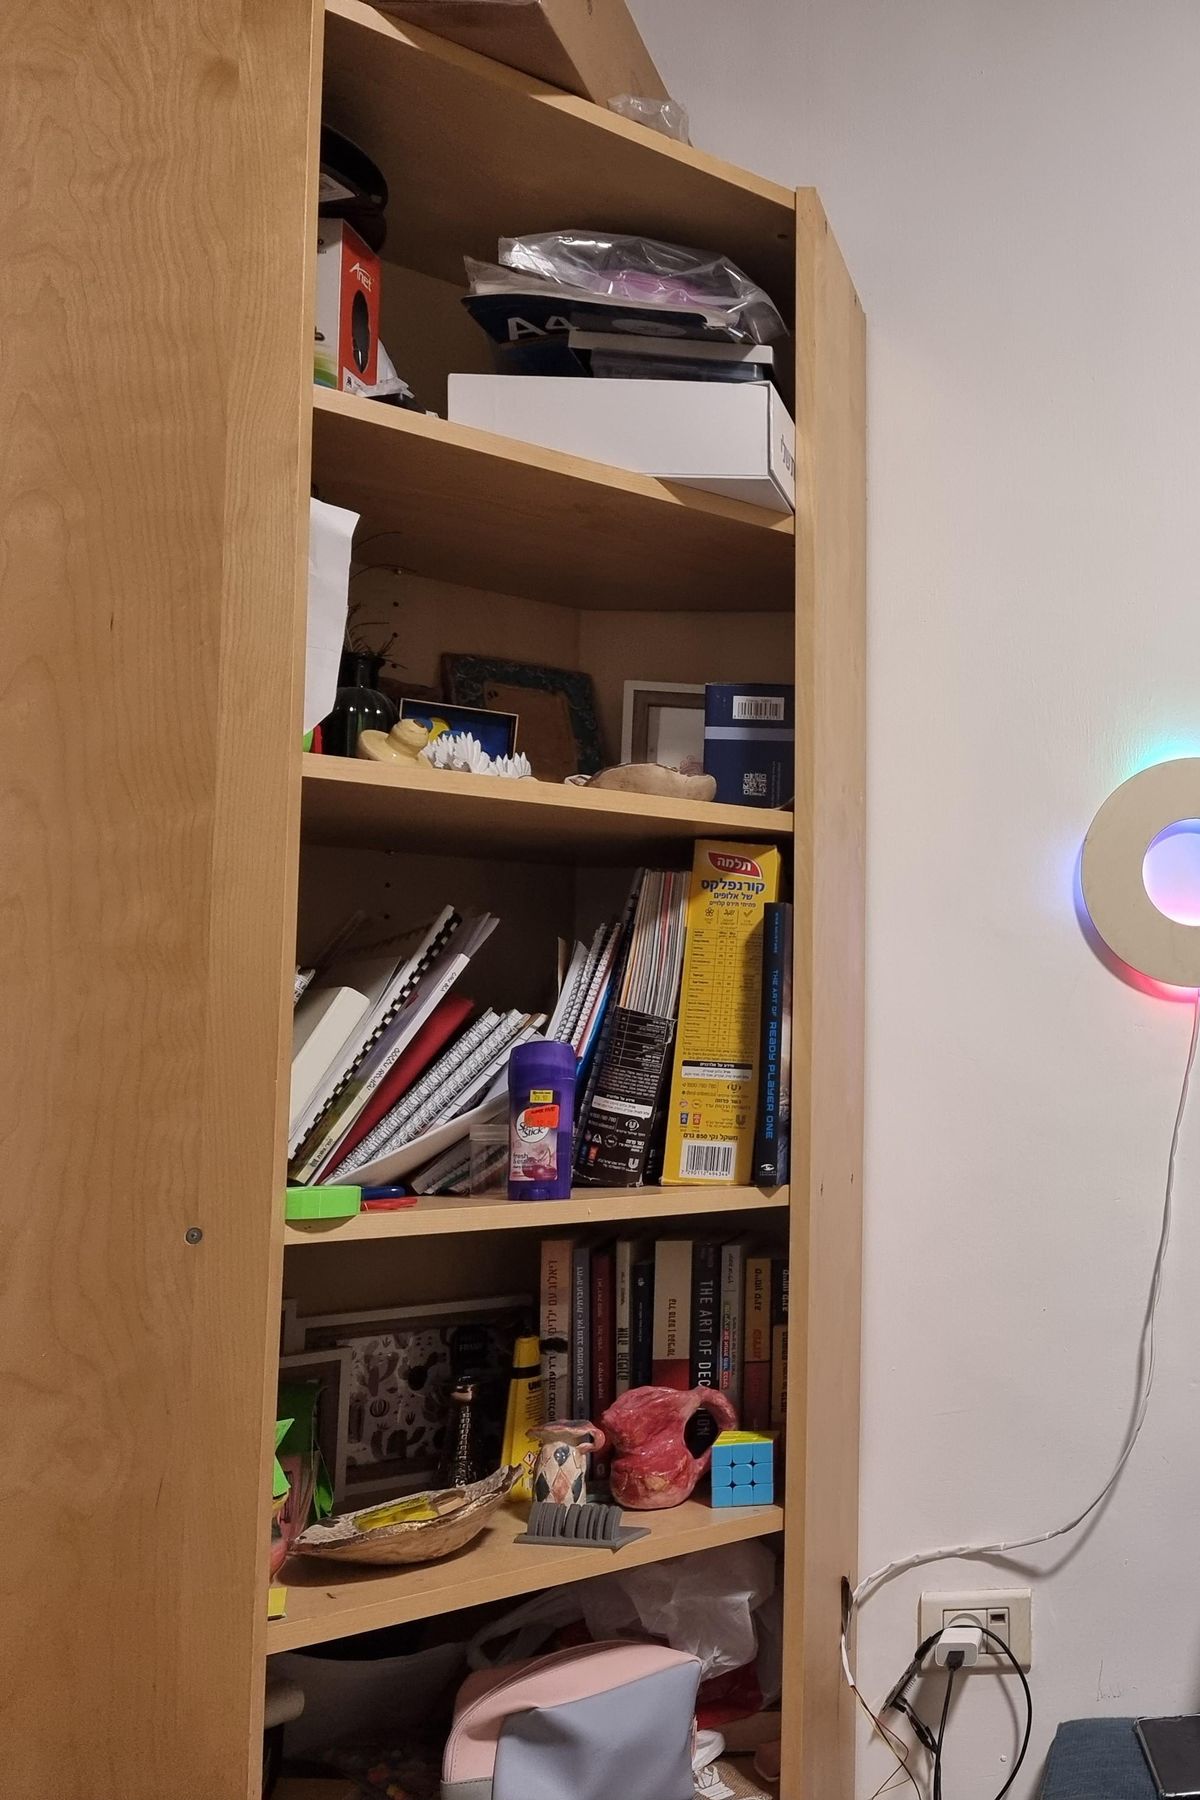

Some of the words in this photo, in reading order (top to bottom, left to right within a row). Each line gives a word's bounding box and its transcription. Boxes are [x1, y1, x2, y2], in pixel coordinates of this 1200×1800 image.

[350, 262, 373, 292] Anet
[507, 315, 580, 341] A4
[717, 857, 752, 872] תלמה
[701, 878, 765, 895] קורנפלקס
[714, 891, 739, 900] אלופים
[741, 892, 753, 901] של
[771, 1005, 778, 1017] OF
[768, 1021, 777, 1060] READY
[766, 1064, 775, 1112] PLAYER
[522, 1128, 544, 1138] Stick
[765, 1115, 774, 1139] ONE
[720, 1133, 739, 1141] משקל
[547, 1260, 558, 1288] דיאלוג
[576, 1267, 584, 1285] דחייה
[548, 1291, 557, 1306] עם
[576, 1286, 584, 1313] חברתית
[700, 1280, 713, 1303] THE
[547, 1310, 557, 1334] ילדים
[576, 1319, 585, 1329] אין
[699, 1310, 713, 1333] ART
[576, 1329, 584, 1344] מצב
[698, 1340, 711, 1356] OF
[577, 1374, 584, 1385] את
